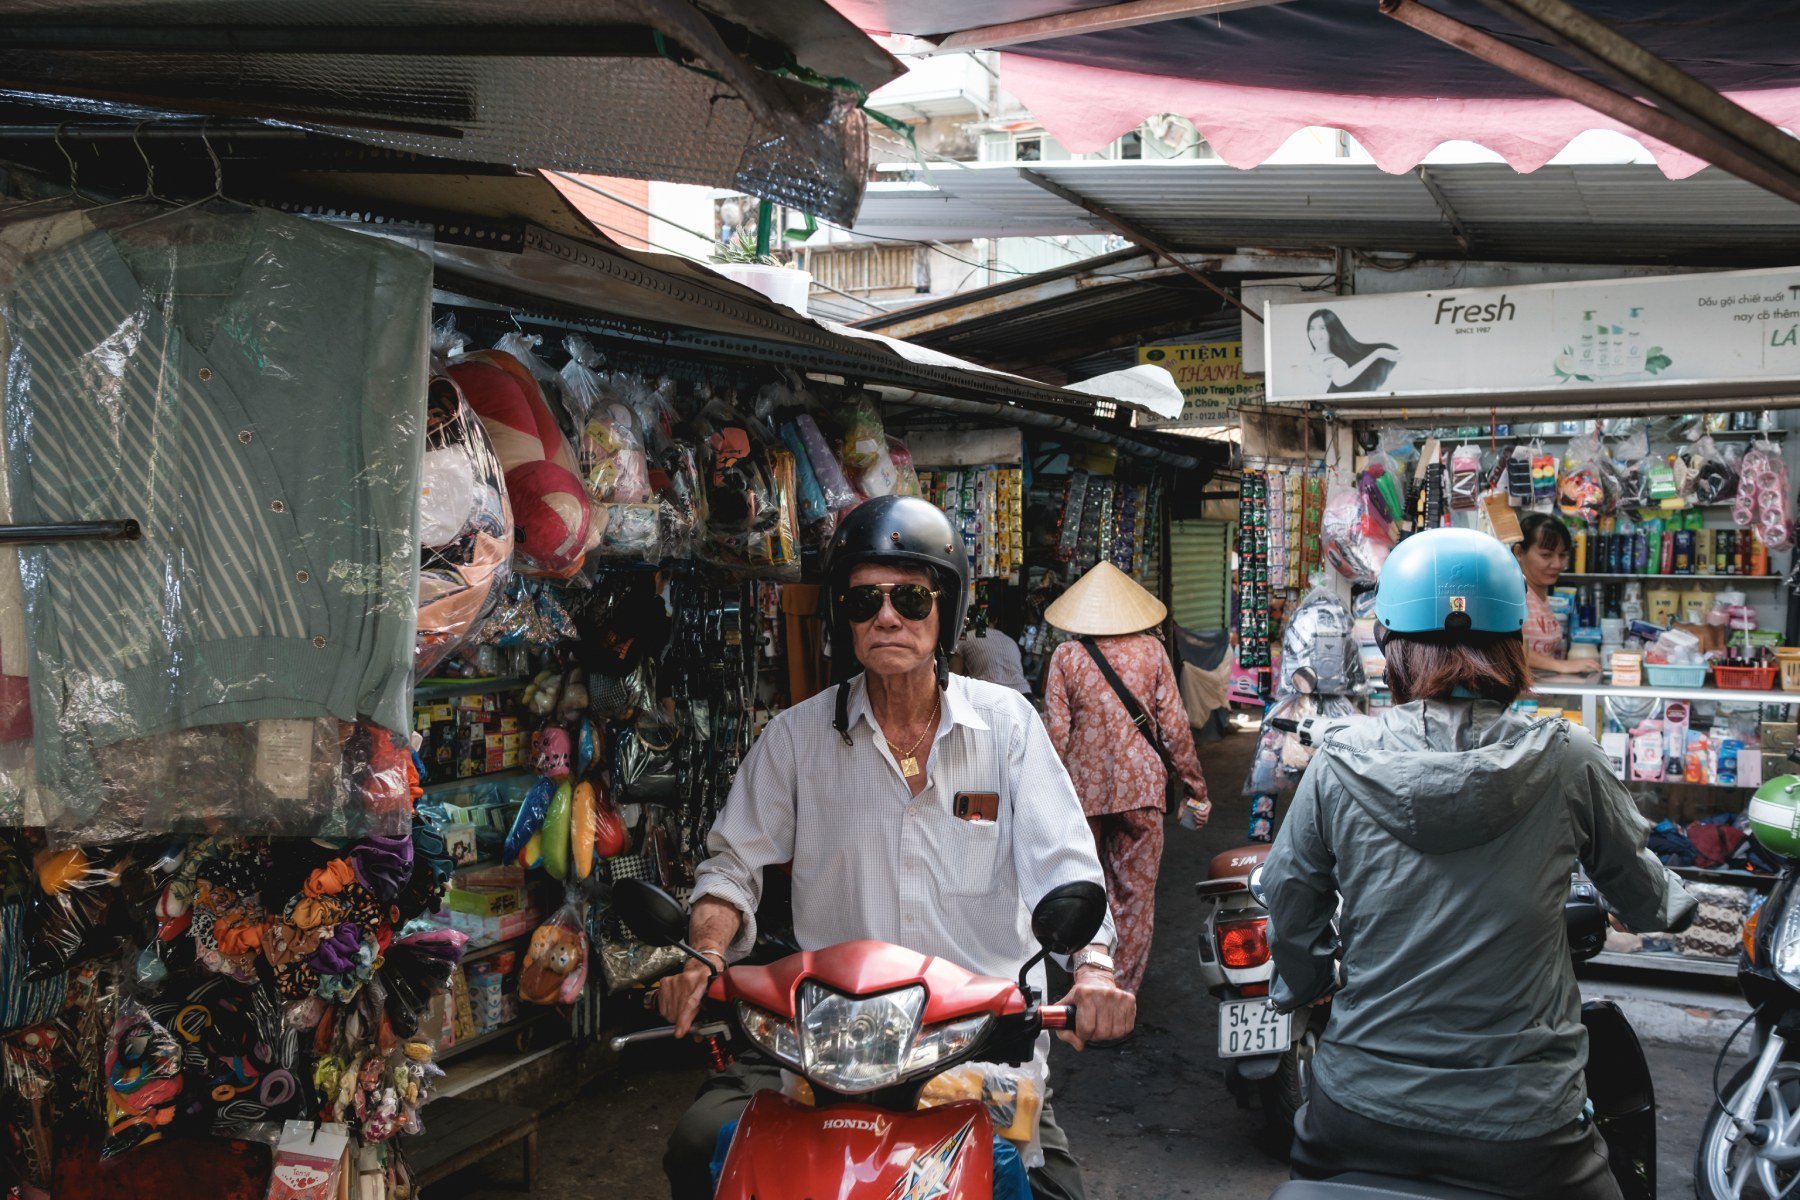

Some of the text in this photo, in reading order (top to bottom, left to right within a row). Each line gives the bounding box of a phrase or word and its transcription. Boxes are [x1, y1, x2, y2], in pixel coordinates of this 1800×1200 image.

[1435, 294, 1515, 325] Fresh
[1733, 313, 1754, 323] nay
[1772, 308, 1800, 319] thêm
[1455, 326, 1491, 335] SINCE 1987
[1771, 324, 1798, 347] LÁ
[1176, 345, 1227, 363] TIỆM
[1177, 363, 1241, 382] THANH
[1209, 384, 1235, 396] Trang
[1195, 398, 1220, 408] Chữa
[1200, 411, 1216, 420] 0122
[1230, 1026, 1276, 1052] 0251
[823, 1118, 877, 1131] HONDA
